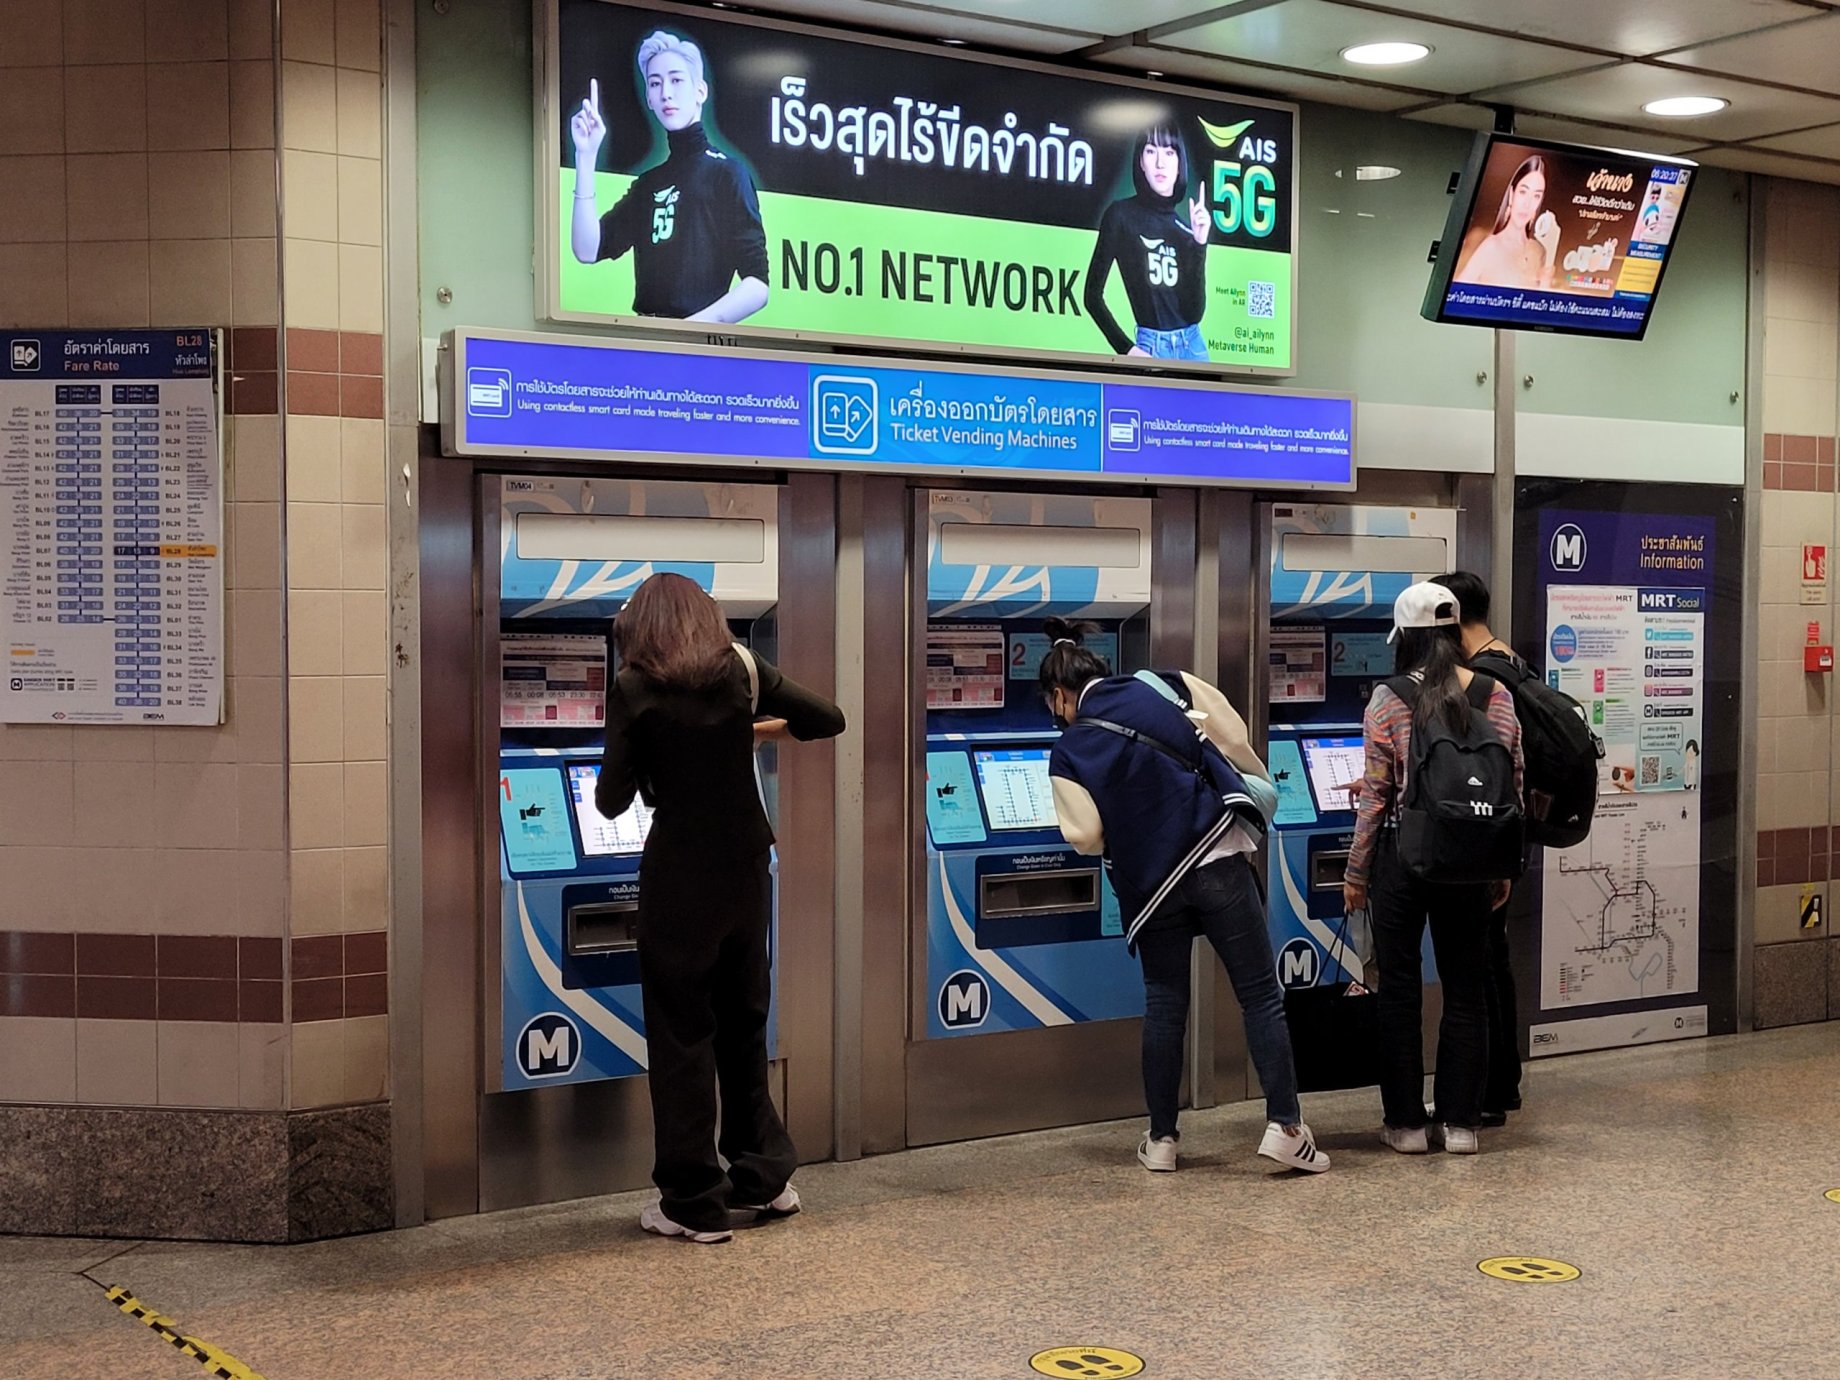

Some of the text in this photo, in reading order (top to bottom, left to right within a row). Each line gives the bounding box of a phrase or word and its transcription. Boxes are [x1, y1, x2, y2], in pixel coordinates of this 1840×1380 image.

[771, 76, 1094, 185] เร็วสุดไร้ขีดจำกัด
[1239, 137, 1277, 163] AIS
[1213, 159, 1276, 238] 5G
[652, 204, 675, 243] 5G
[1159, 245, 1176, 257] AIS
[782, 239, 1082, 317] NO.1 NETWORK
[1148, 252, 1178, 286] 5G
[64, 338, 150, 355] อัตราค่าโดยสาร
[176, 336, 203, 347] BL28
[1208, 339, 1274, 354] Metaverse Human
[64, 361, 120, 372] Fare Rate
[518, 399, 541, 413] Using
[544, 401, 586, 413] contactless
[589, 405, 610, 414] smart
[613, 404, 631, 415] card
[634, 405, 655, 416] made
[658, 408, 691, 421] traveling
[693, 408, 713, 420] faster
[716, 410, 731, 421] and
[889, 380, 1097, 427] เครื่องออกบัตรโดยสาร
[892, 423, 1077, 450] Ticket Vending Machines
[1556, 534, 1581, 566] M
[1641, 534, 1704, 552] ประชาสัมพันธ์
[1640, 553, 1704, 570] Information
[1641, 594, 1700, 608] MRT Social
[1012, 643, 1026, 665] 2
[1334, 642, 1345, 662] 2
[500, 777, 512, 801] 1
[1284, 949, 1312, 983] M
[948, 983, 981, 1021] M
[528, 1027, 569, 1070] M
